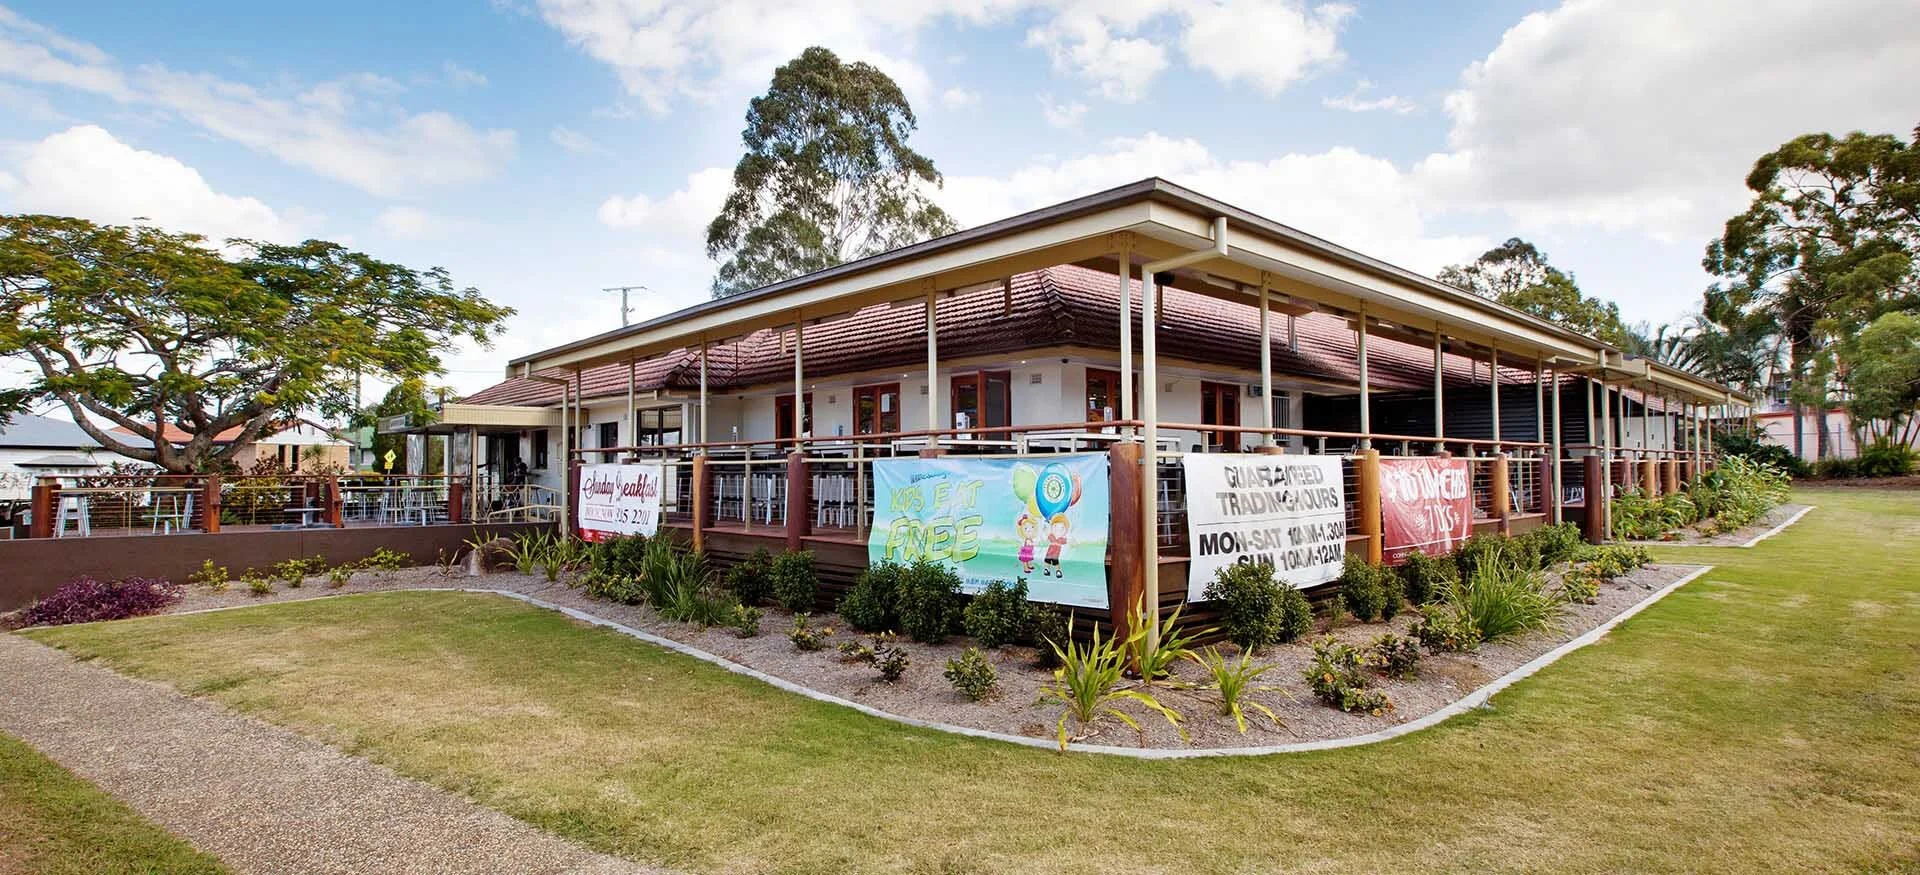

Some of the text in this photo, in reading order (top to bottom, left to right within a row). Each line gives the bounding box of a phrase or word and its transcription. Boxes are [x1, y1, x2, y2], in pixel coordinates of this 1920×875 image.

[582, 470, 615, 503] Sunday
[889, 484, 926, 512] KIDS
[1216, 486, 1294, 517] TRADING
[885, 514, 983, 563] FREE
[1199, 527, 1282, 556] MON-SAT
[1280, 543, 1342, 572] 10AM-12AM
